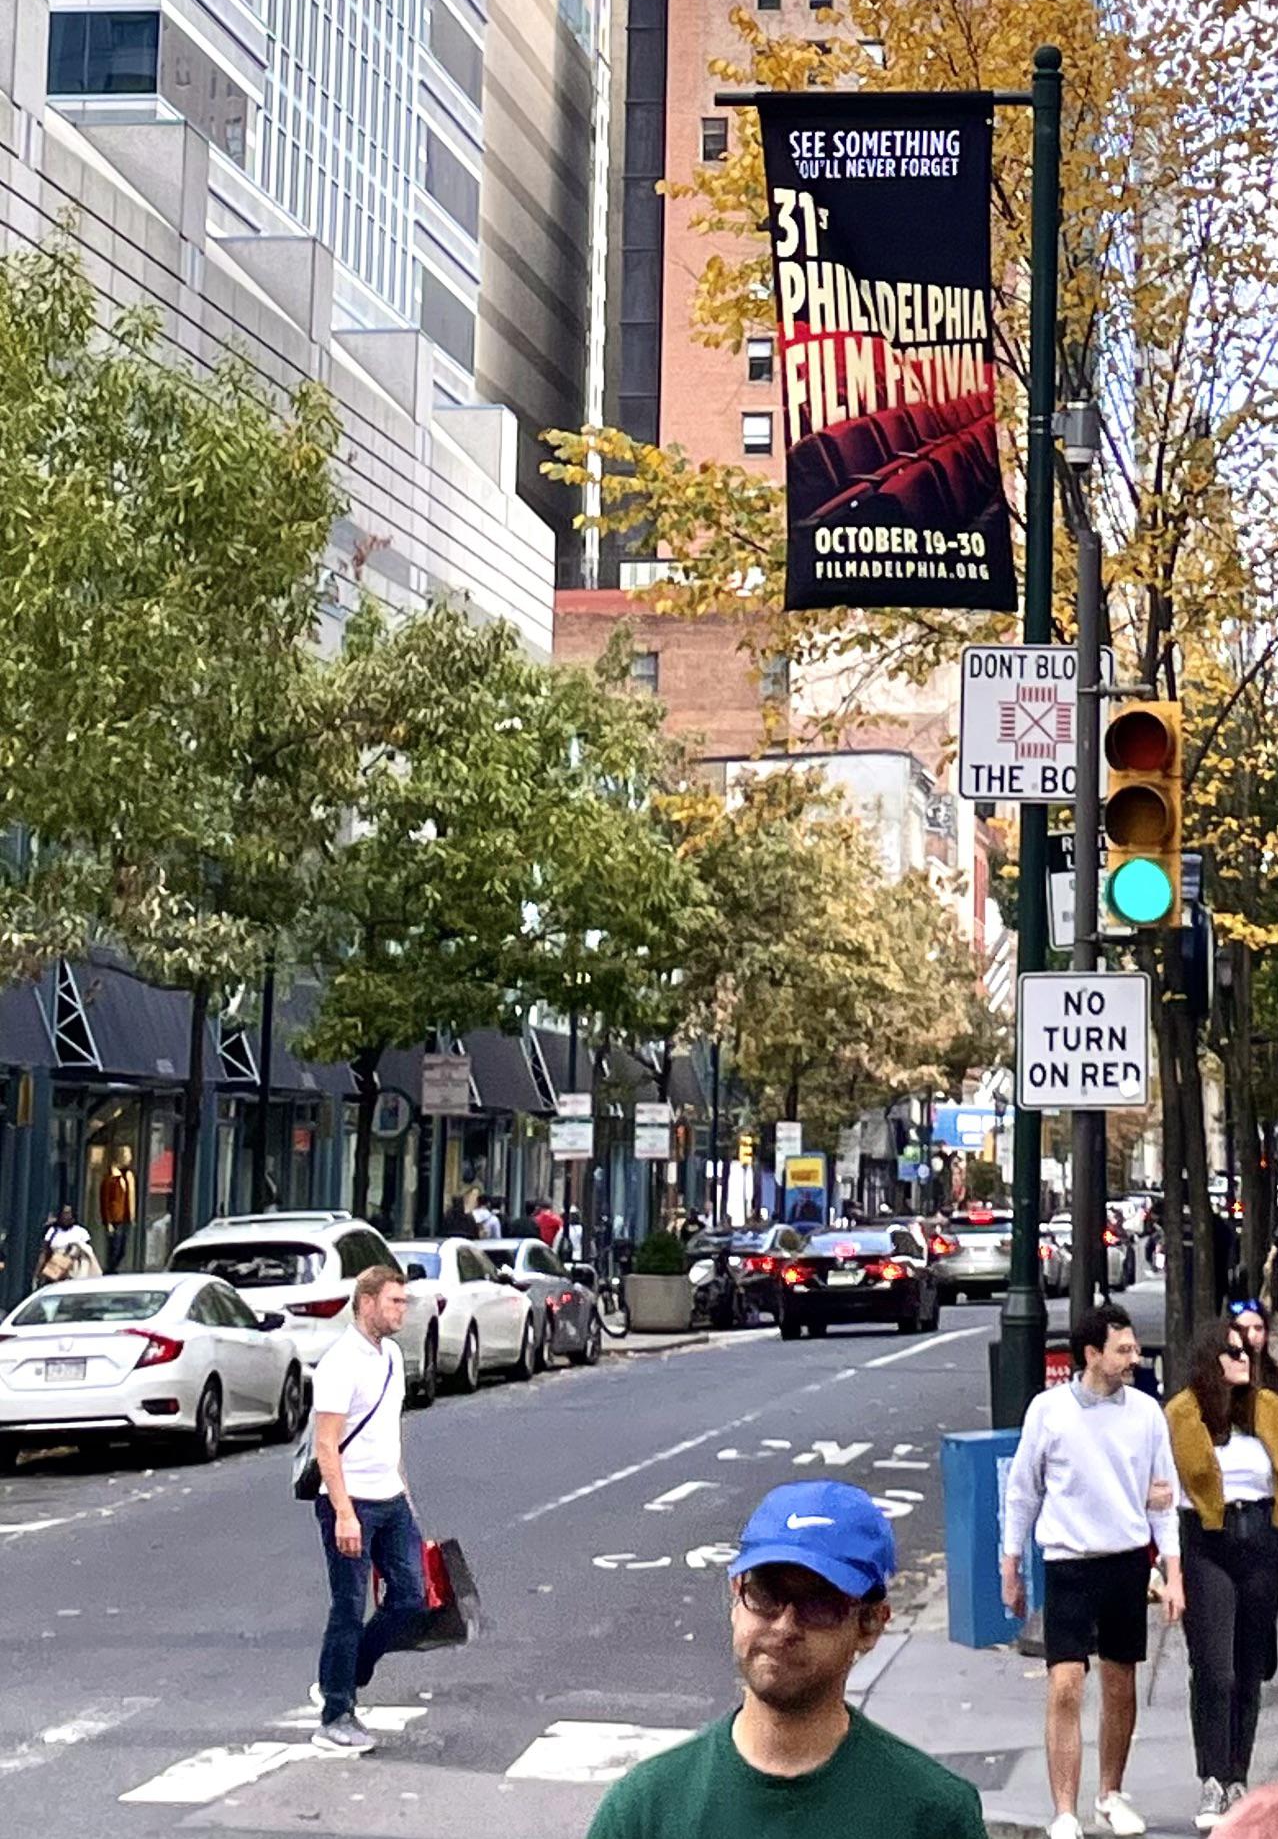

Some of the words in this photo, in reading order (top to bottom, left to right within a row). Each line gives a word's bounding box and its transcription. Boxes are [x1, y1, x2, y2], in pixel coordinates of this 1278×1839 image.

[789, 130, 826, 158] SEE
[832, 129, 960, 158] SOMETHING
[845, 158, 896, 178] NEVER
[899, 157, 960, 177] FORGET
[785, 335, 877, 446] FILM
[815, 526, 918, 554] OCTOBER
[923, 529, 986, 557] 19-30
[815, 560, 990, 580] FILMADELPHIA.ORG
[970, 653, 1027, 679] DONT
[1036, 655, 1076, 680] BLO
[970, 764, 1024, 793] THE
[1041, 765, 1077, 794] BO
[1064, 990, 1105, 1016] NO
[1043, 1026, 1127, 1051] TURN
[1029, 1062, 1068, 1088] ON
[1081, 1062, 1140, 1088] RED
